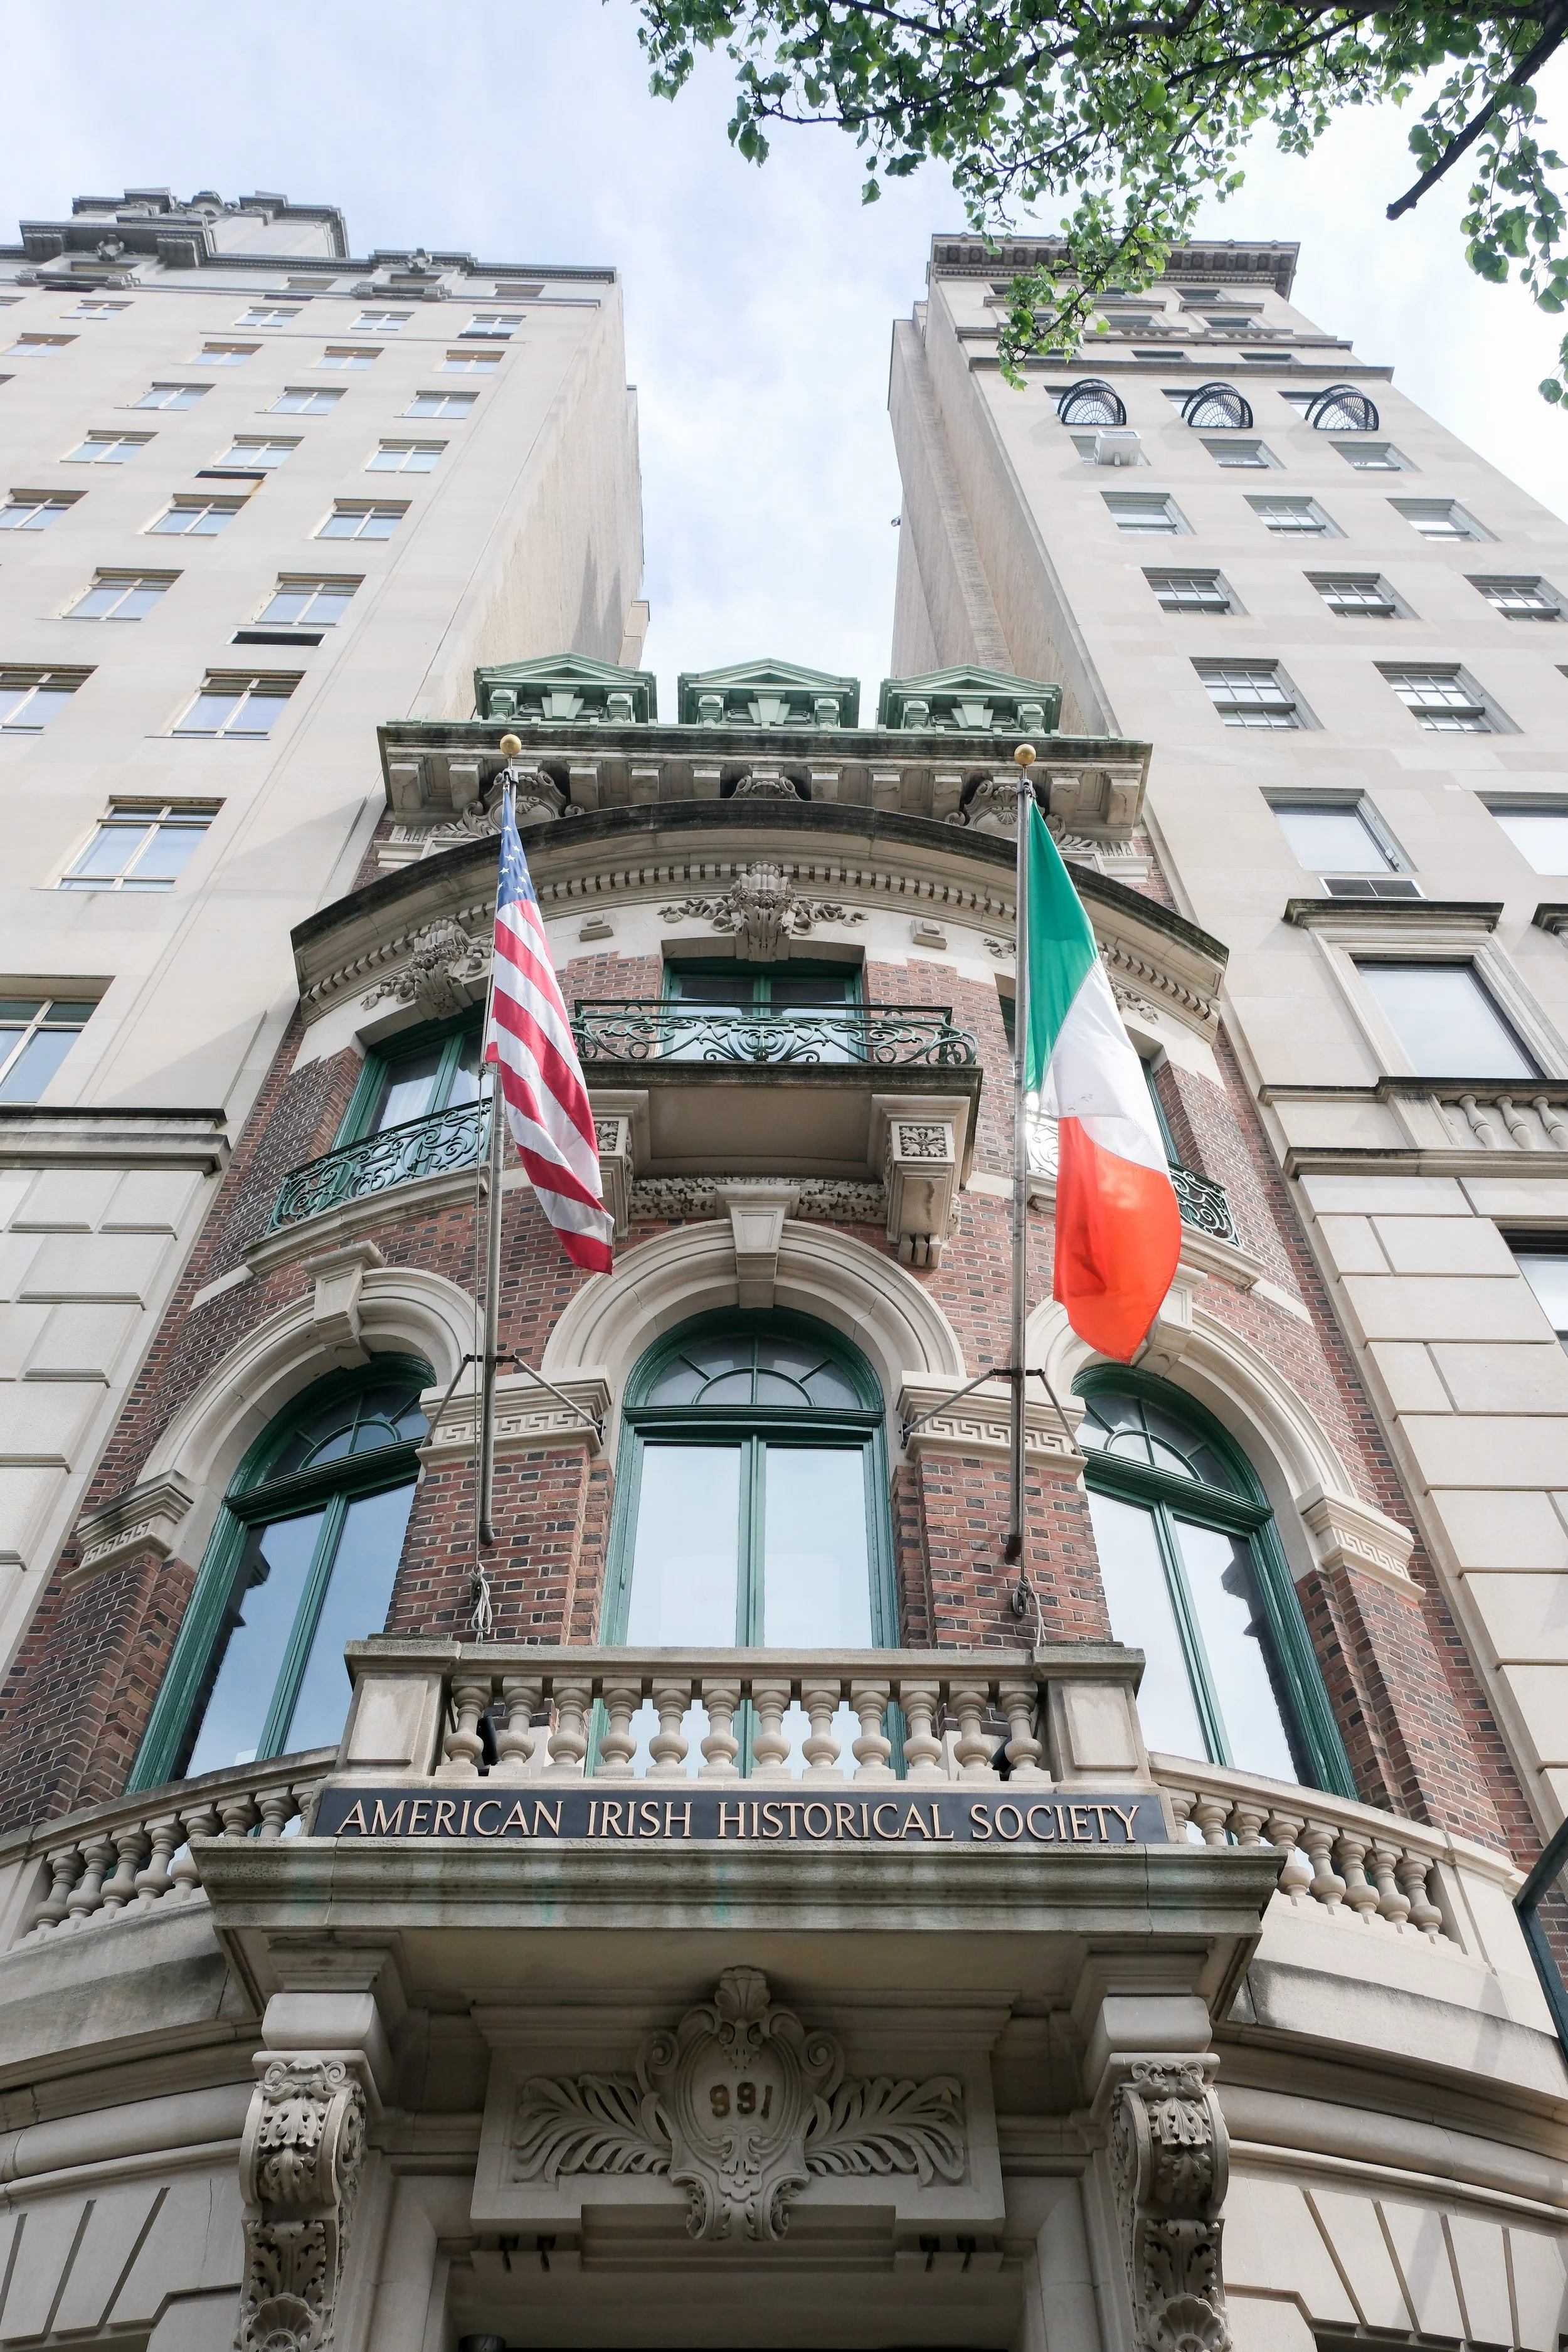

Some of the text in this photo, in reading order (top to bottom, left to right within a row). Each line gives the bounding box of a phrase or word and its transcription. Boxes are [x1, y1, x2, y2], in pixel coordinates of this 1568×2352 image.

[335, 1799, 1140, 1841] AMERICAN IRISH HISTORICAL SOCIETY
[710, 2082, 773, 2119] 991
